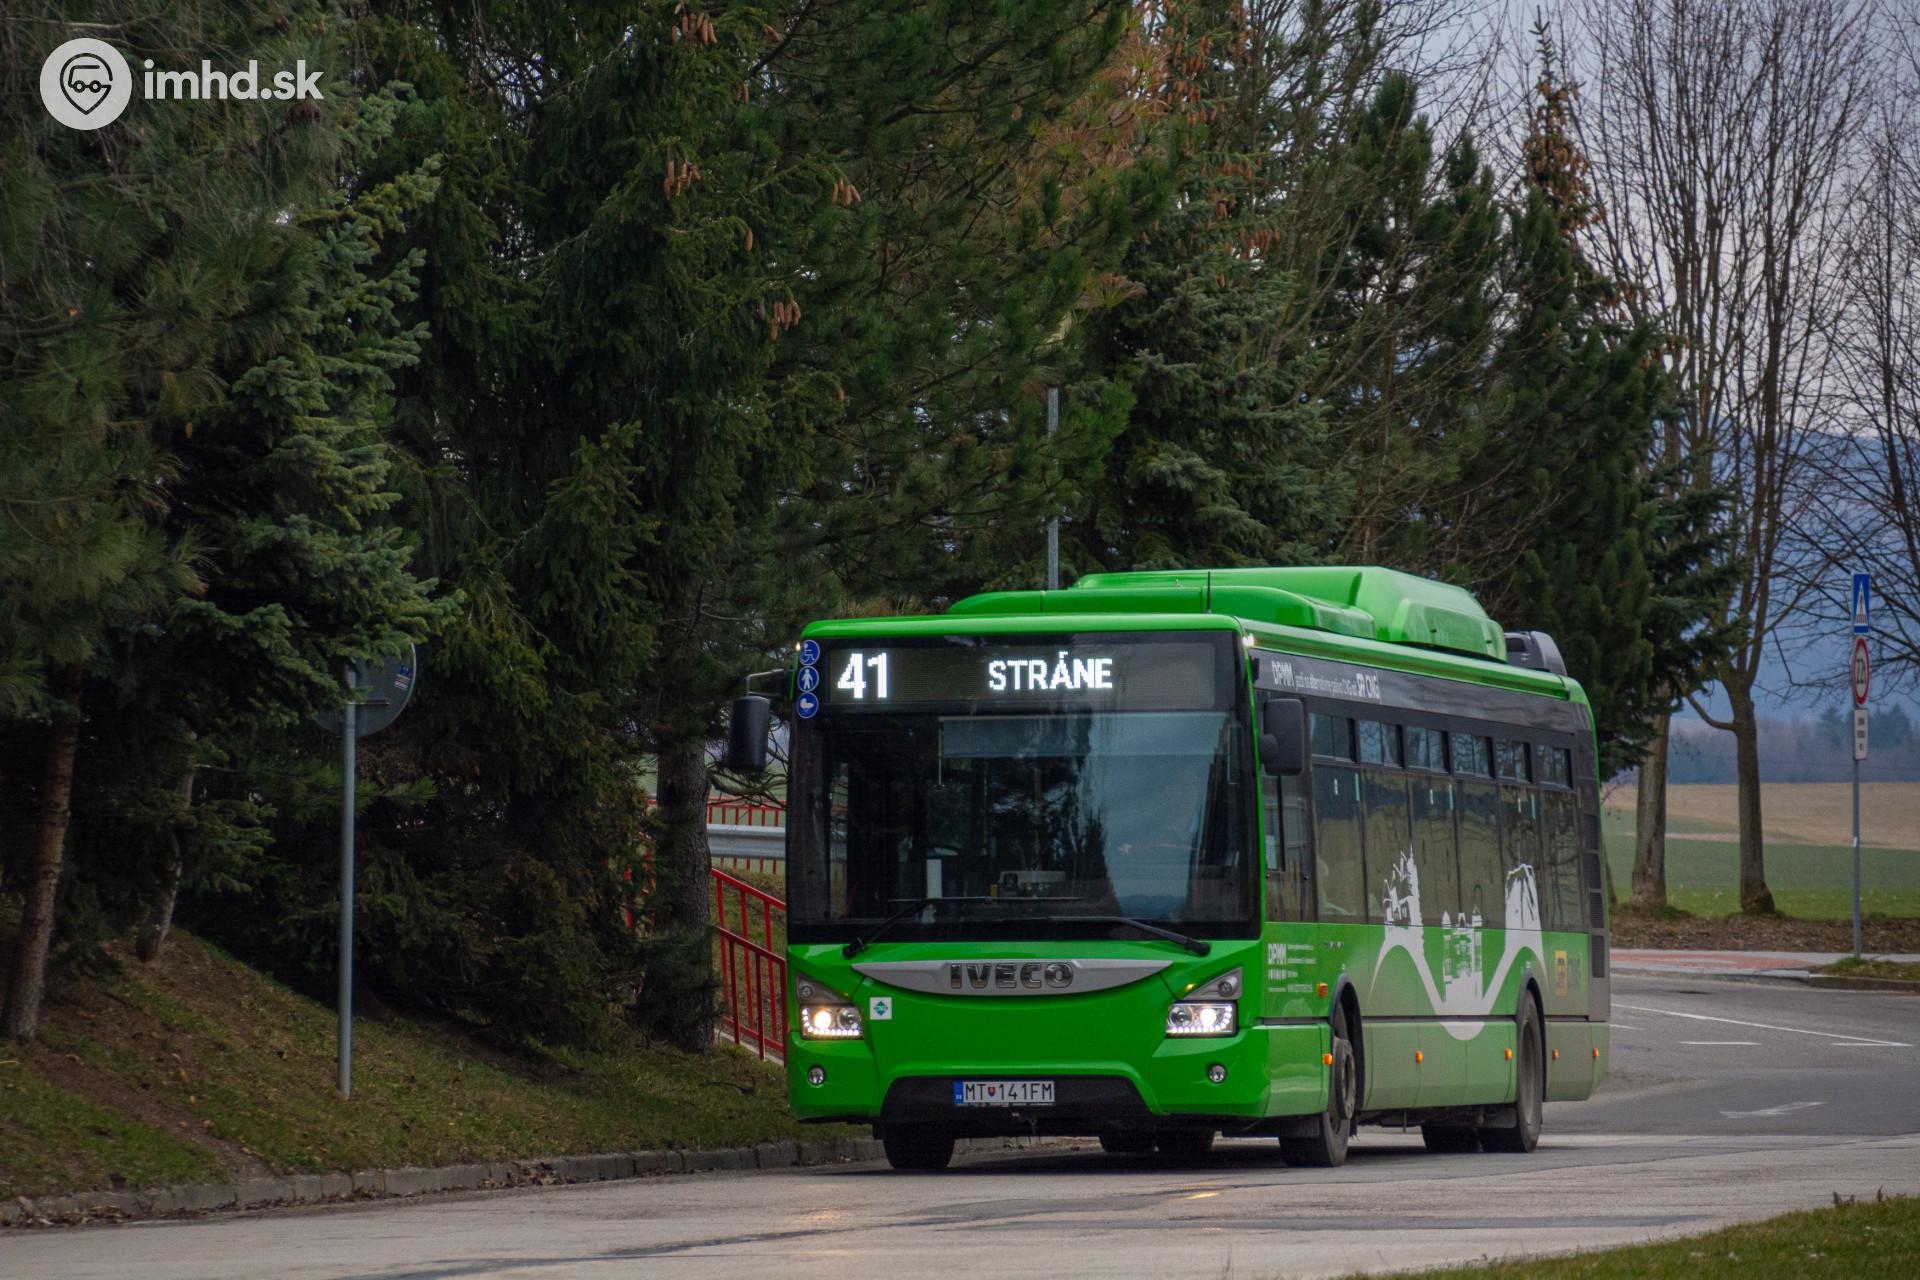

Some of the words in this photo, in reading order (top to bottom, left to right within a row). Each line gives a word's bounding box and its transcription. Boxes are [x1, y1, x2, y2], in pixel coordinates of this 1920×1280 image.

[837, 653, 888, 698] 41
[988, 650, 1113, 690] STRÁNE
[950, 962, 1074, 989] IVECO
